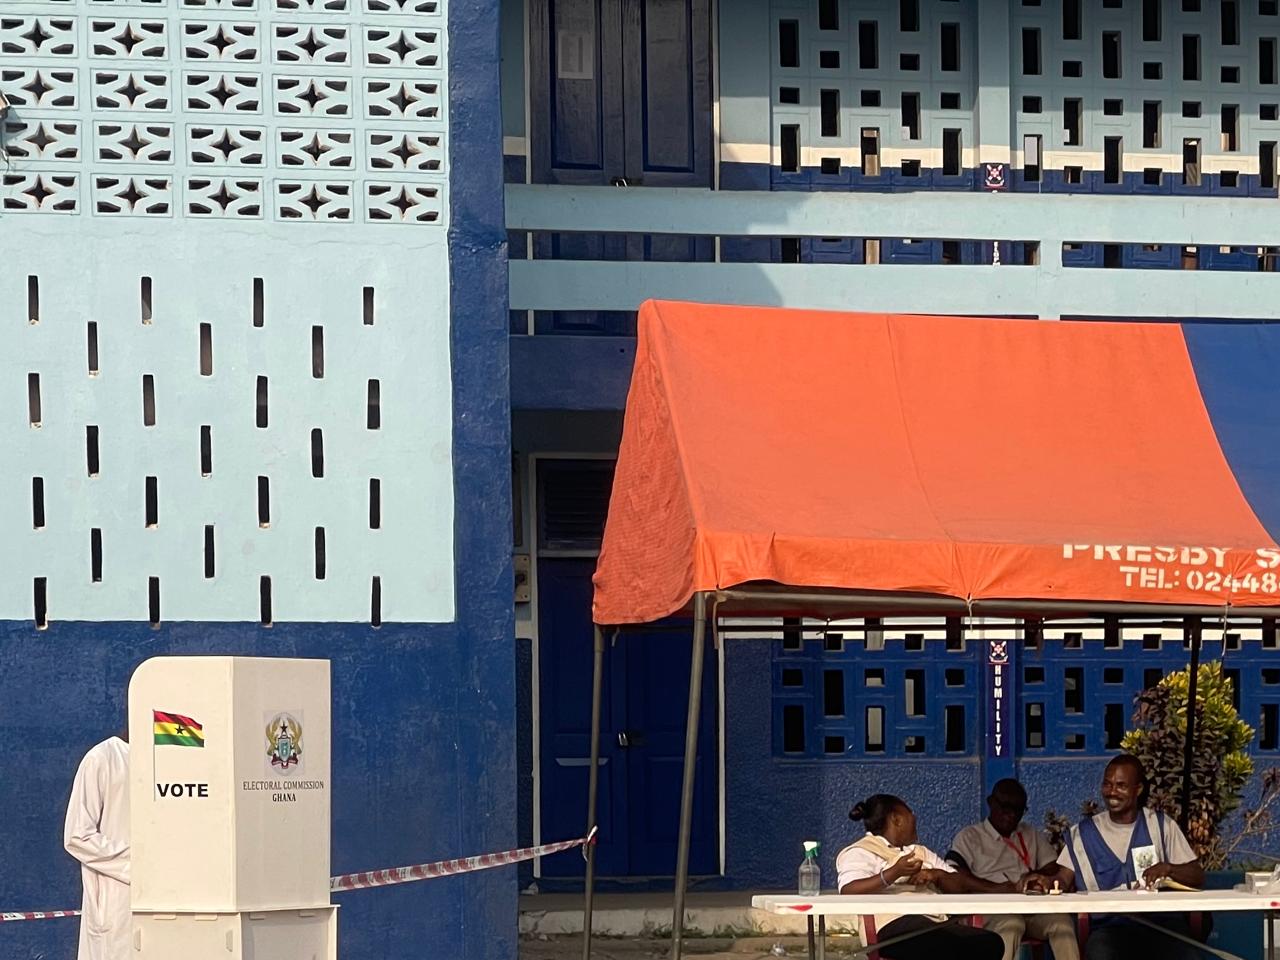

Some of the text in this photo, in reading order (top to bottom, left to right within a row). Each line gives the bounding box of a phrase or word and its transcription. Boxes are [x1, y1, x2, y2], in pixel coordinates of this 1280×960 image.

[994, 665, 1002, 756] HUMILITY
[157, 783, 208, 797] VOTE
[243, 781, 324, 790] ELECTORAL COMMISSION
[272, 794, 296, 802] GHANA
